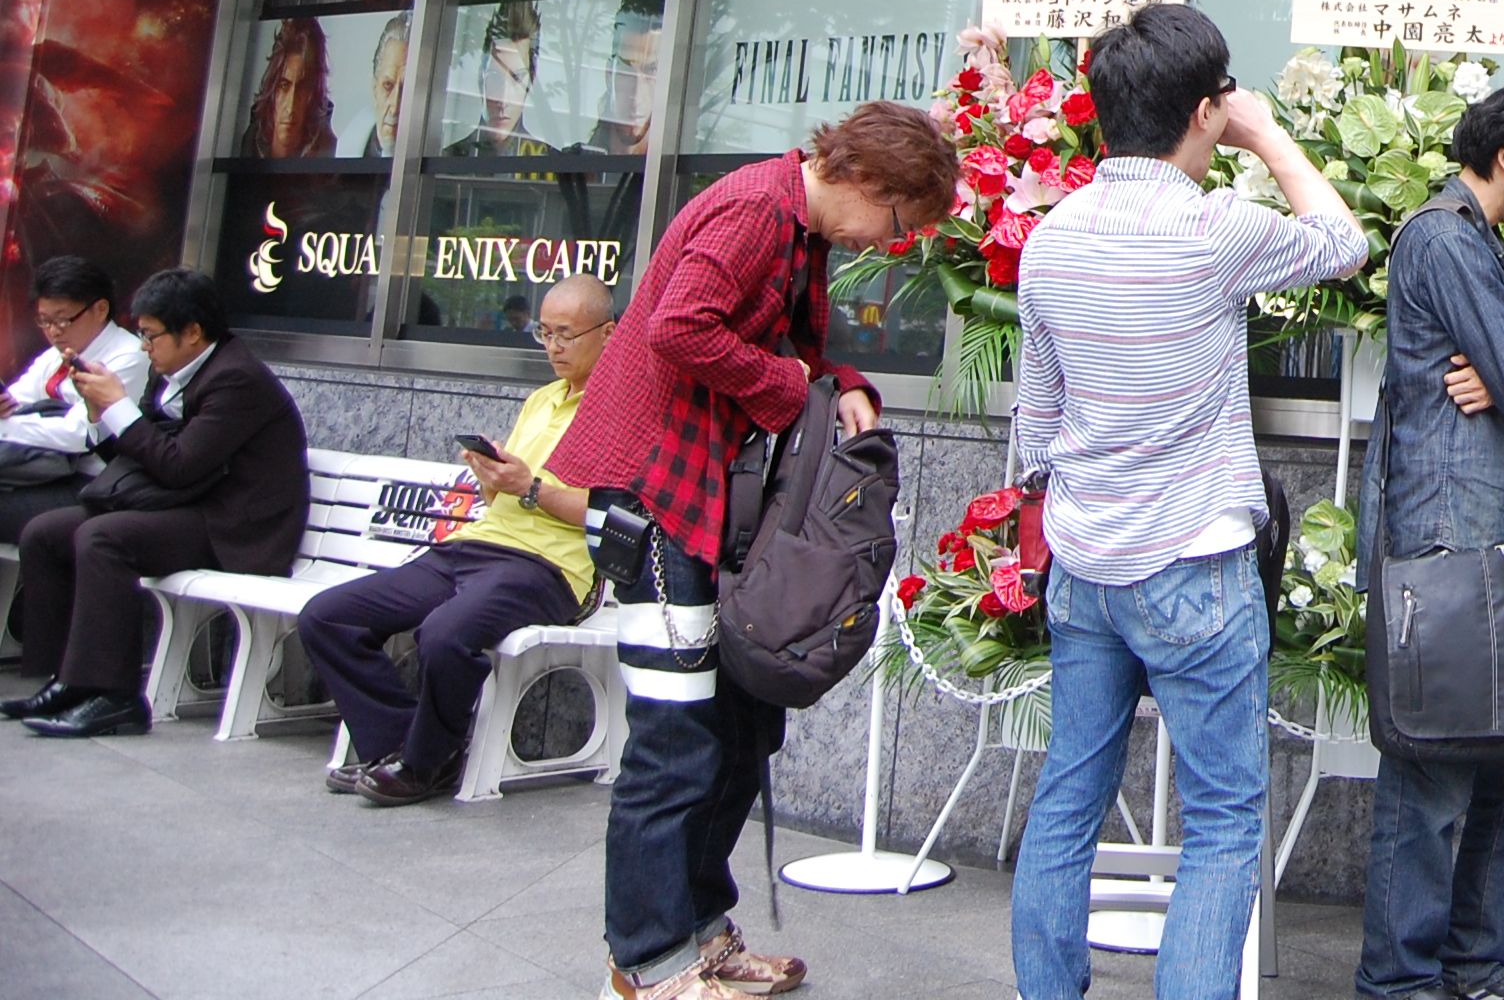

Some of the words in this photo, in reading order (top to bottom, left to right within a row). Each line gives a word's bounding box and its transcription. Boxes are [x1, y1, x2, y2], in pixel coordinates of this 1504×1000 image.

[731, 38, 810, 105] FINAL
[822, 31, 949, 103] FANTASY
[297, 231, 390, 279] SQUA
[433, 235, 519, 281] ENIX
[525, 238, 621, 287] CAFE
